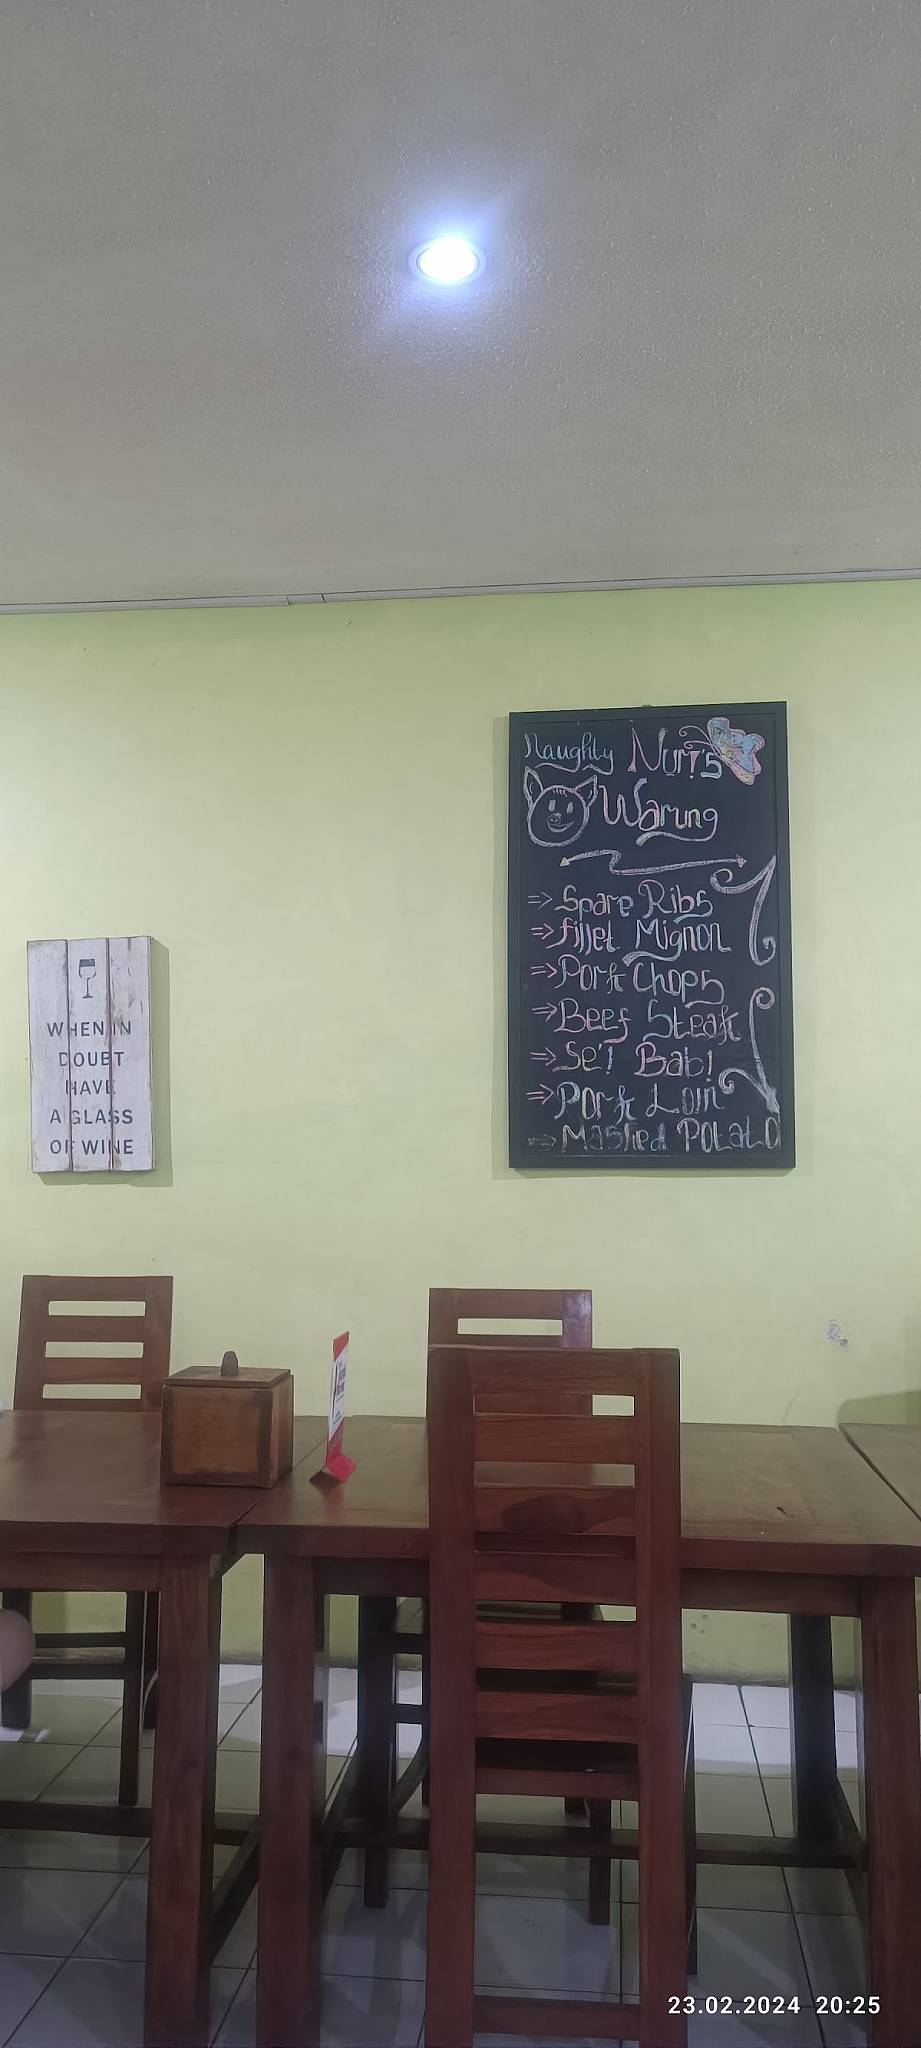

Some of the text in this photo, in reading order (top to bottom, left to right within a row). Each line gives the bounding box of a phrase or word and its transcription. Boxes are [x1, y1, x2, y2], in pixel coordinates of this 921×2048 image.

[524, 732, 614, 775] Naughty
[599, 778, 718, 846] Warung
[554, 879, 714, 923] Spare Ribs
[622, 919, 732, 966] Mignon
[554, 954, 725, 1008] Pork Chops
[46, 1020, 131, 1037] WHEN IN
[554, 998, 742, 1045] Beef Steak
[59, 1051, 125, 1067] DOUBT
[65, 1079, 116, 1095] HAVE
[554, 1081, 638, 1124] Pork
[50, 1109, 133, 1124] A GLASS
[82, 1139, 134, 1155] WINE
